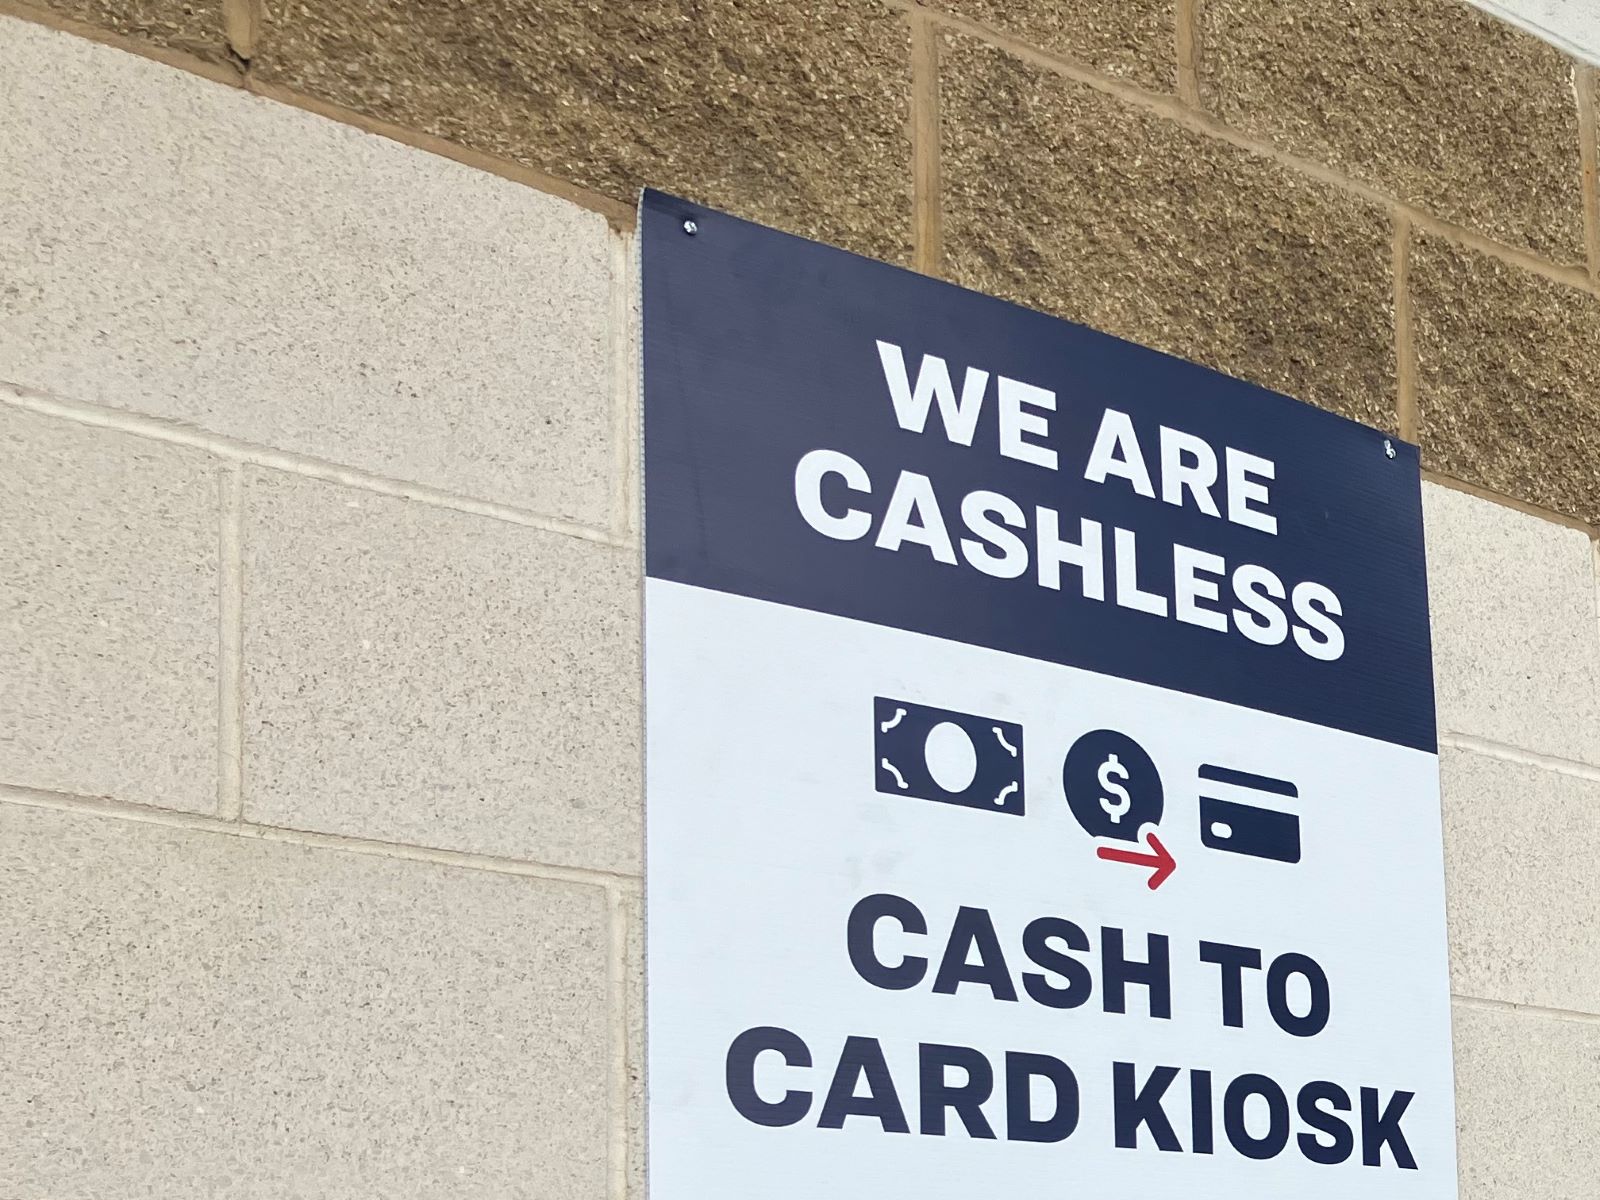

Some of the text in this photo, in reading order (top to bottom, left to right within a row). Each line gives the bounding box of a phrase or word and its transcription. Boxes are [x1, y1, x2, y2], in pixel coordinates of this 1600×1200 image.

[876, 339, 1278, 536] WE ARE
[794, 448, 1346, 662] CASHLESS
[846, 892, 1331, 1038] CASH TO
[725, 1026, 1418, 1171] CARD KIOSK
